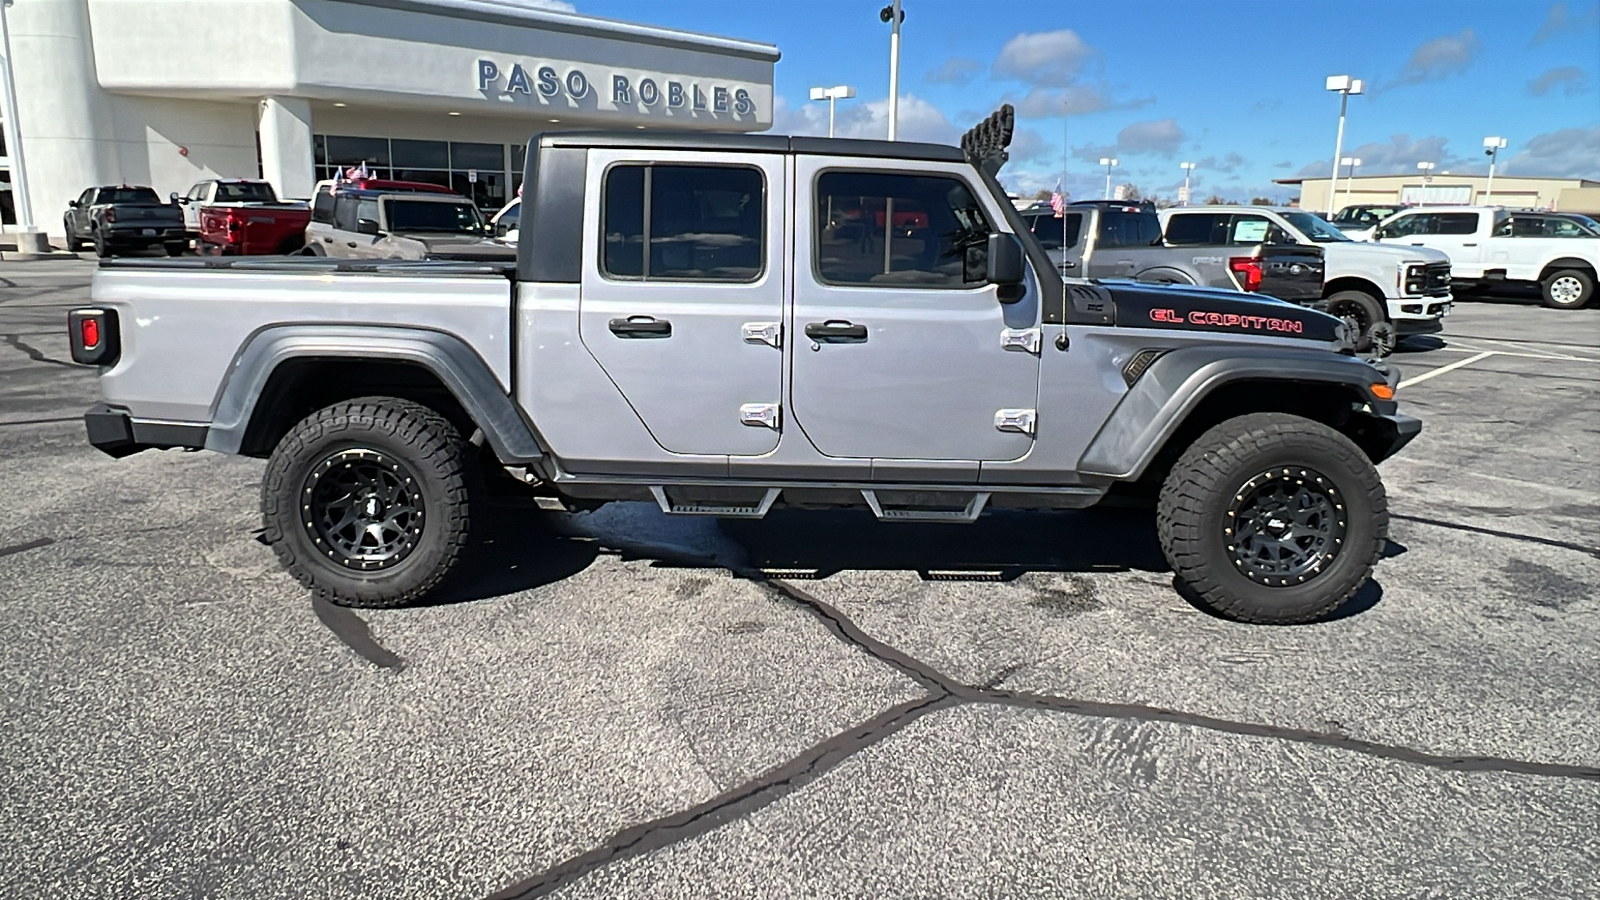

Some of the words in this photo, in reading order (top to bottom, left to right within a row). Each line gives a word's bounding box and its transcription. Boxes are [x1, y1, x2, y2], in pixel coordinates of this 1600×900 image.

[478, 59, 589, 98] PASO
[612, 74, 751, 114] ROBLES
[1149, 308, 1184, 323] EL
[1188, 311, 1303, 333] CAPITAN
